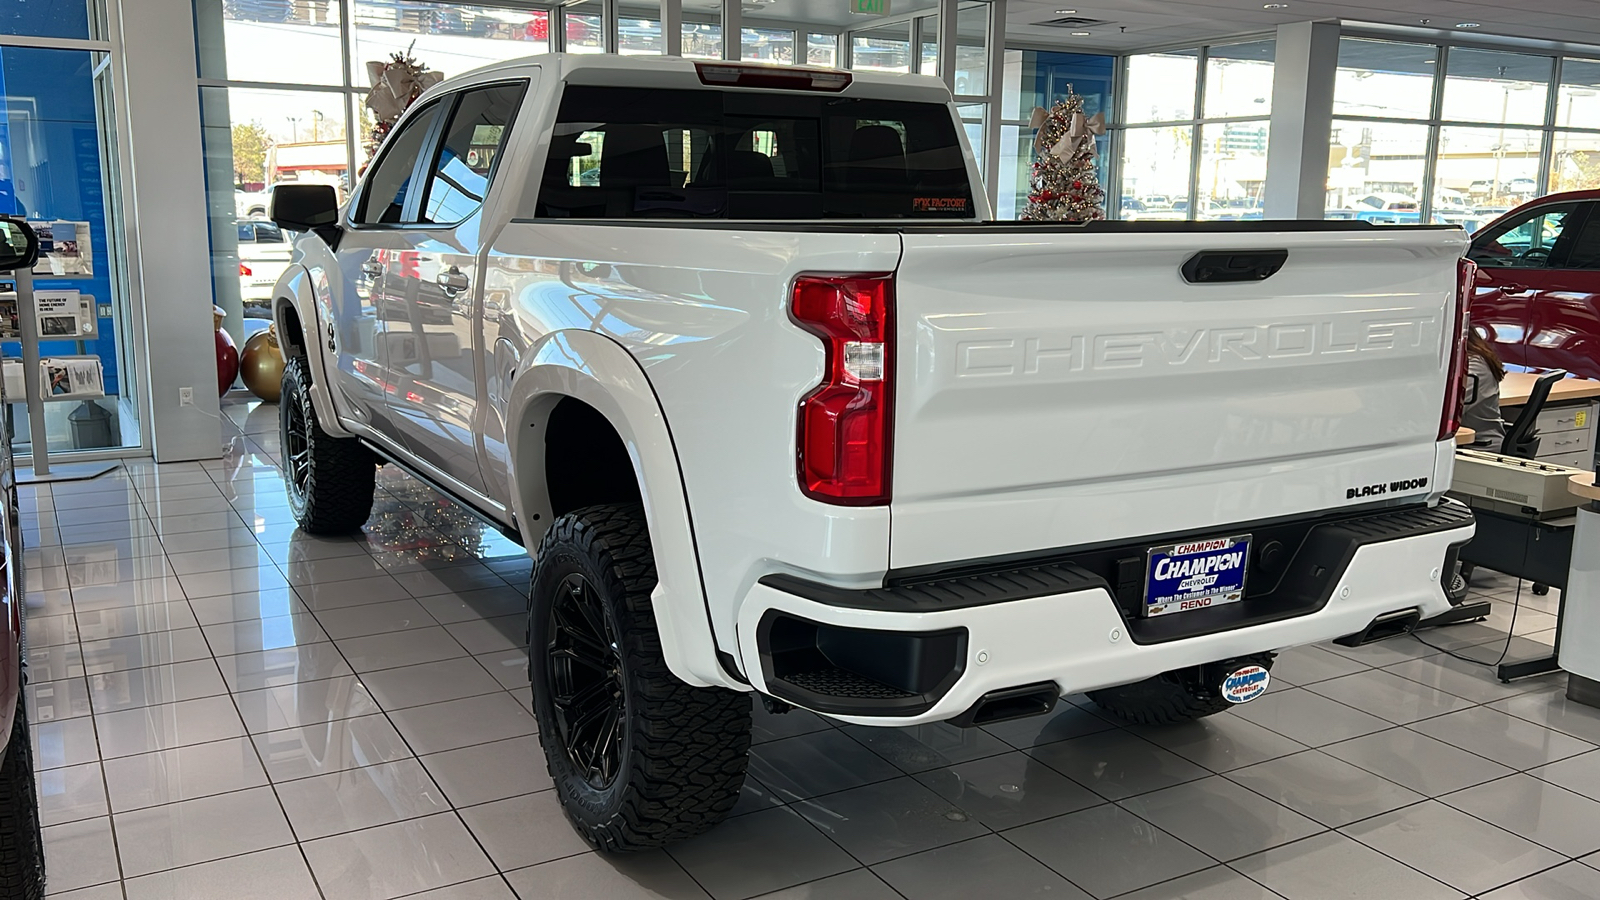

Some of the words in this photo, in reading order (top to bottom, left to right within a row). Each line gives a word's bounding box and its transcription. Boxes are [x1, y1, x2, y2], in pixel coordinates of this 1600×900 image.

[913, 197, 930, 207] FOX
[931, 197, 967, 207] FACTORY
[954, 315, 1435, 378] CHEVROLET
[1346, 483, 1387, 499] BLACK
[1390, 477, 1428, 492] WIDOW
[1177, 540, 1227, 555] CHAMPION
[1154, 551, 1243, 581] CHAMPION
[1180, 576, 1216, 588] CHEVROLET
[1173, 593, 1182, 601] The
[1183, 590, 1205, 600] Customer
[1180, 598, 1212, 610] RENO
[1232, 684, 1259, 695] CHEVROLET
